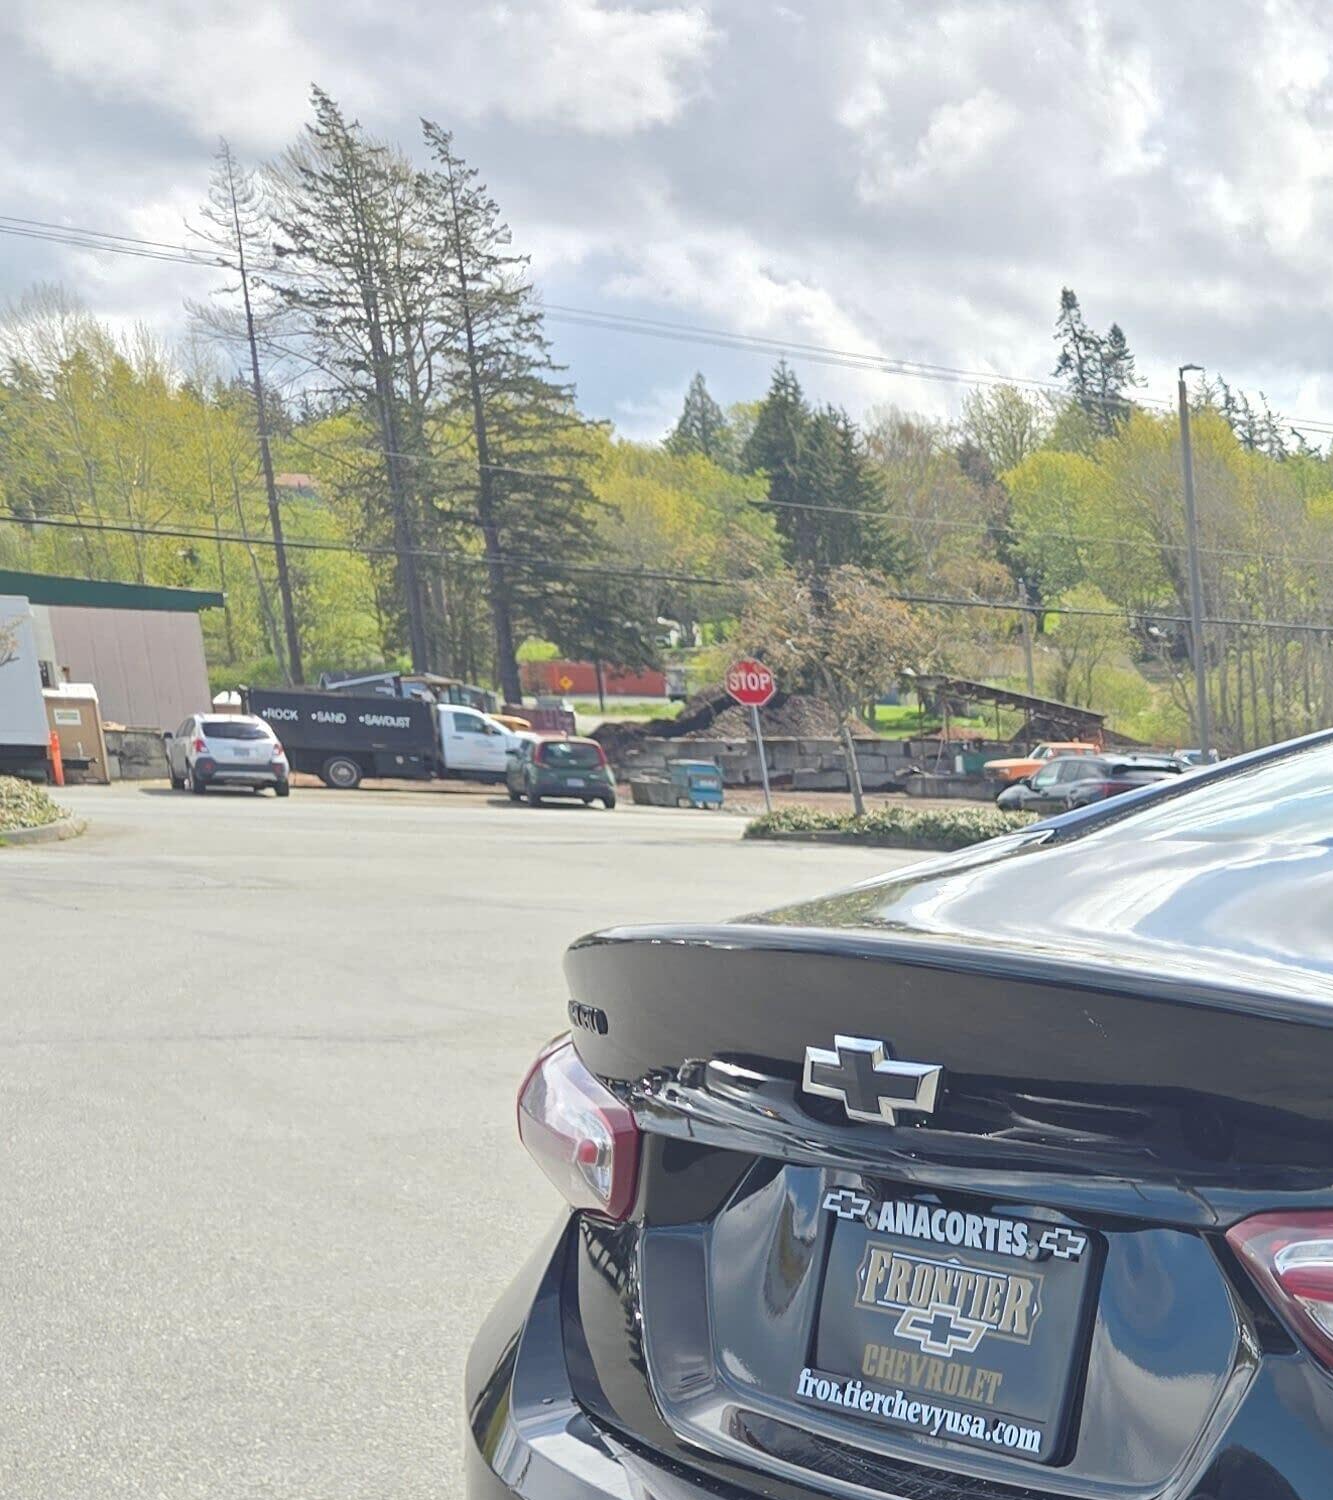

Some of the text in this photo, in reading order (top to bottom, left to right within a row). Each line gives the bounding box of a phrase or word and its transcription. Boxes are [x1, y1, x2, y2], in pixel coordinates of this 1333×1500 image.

[730, 671, 770, 691] STOP
[267, 707, 411, 729] ROCK SAND SAWDUST
[876, 1200, 1030, 1258] ANACORTES
[861, 1247, 1035, 1336] FRONTIER
[862, 1343, 1004, 1406] CHEVROLET
[796, 1367, 1042, 1453] frontierchevyusa.com
